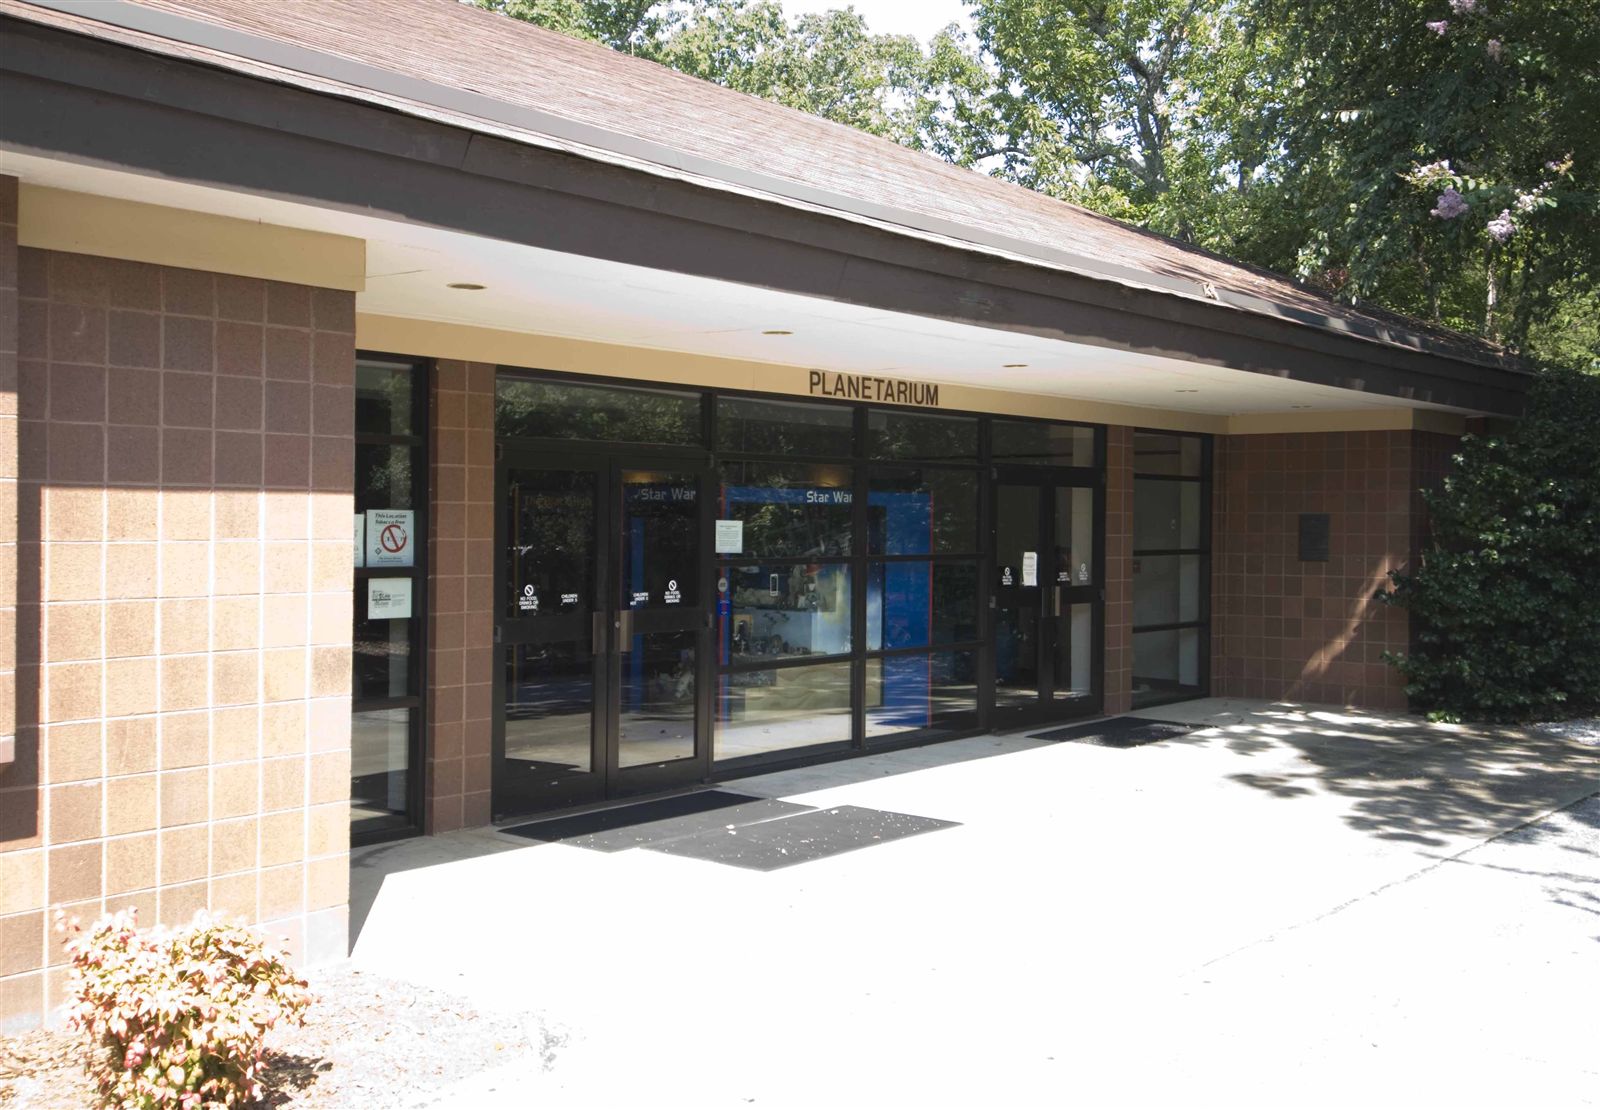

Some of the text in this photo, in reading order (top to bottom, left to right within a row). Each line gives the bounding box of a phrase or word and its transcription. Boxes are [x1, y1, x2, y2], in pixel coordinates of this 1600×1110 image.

[809, 371, 939, 406] PLANETARIUM
[640, 488, 667, 500] Star
[806, 490, 829, 503] Star
